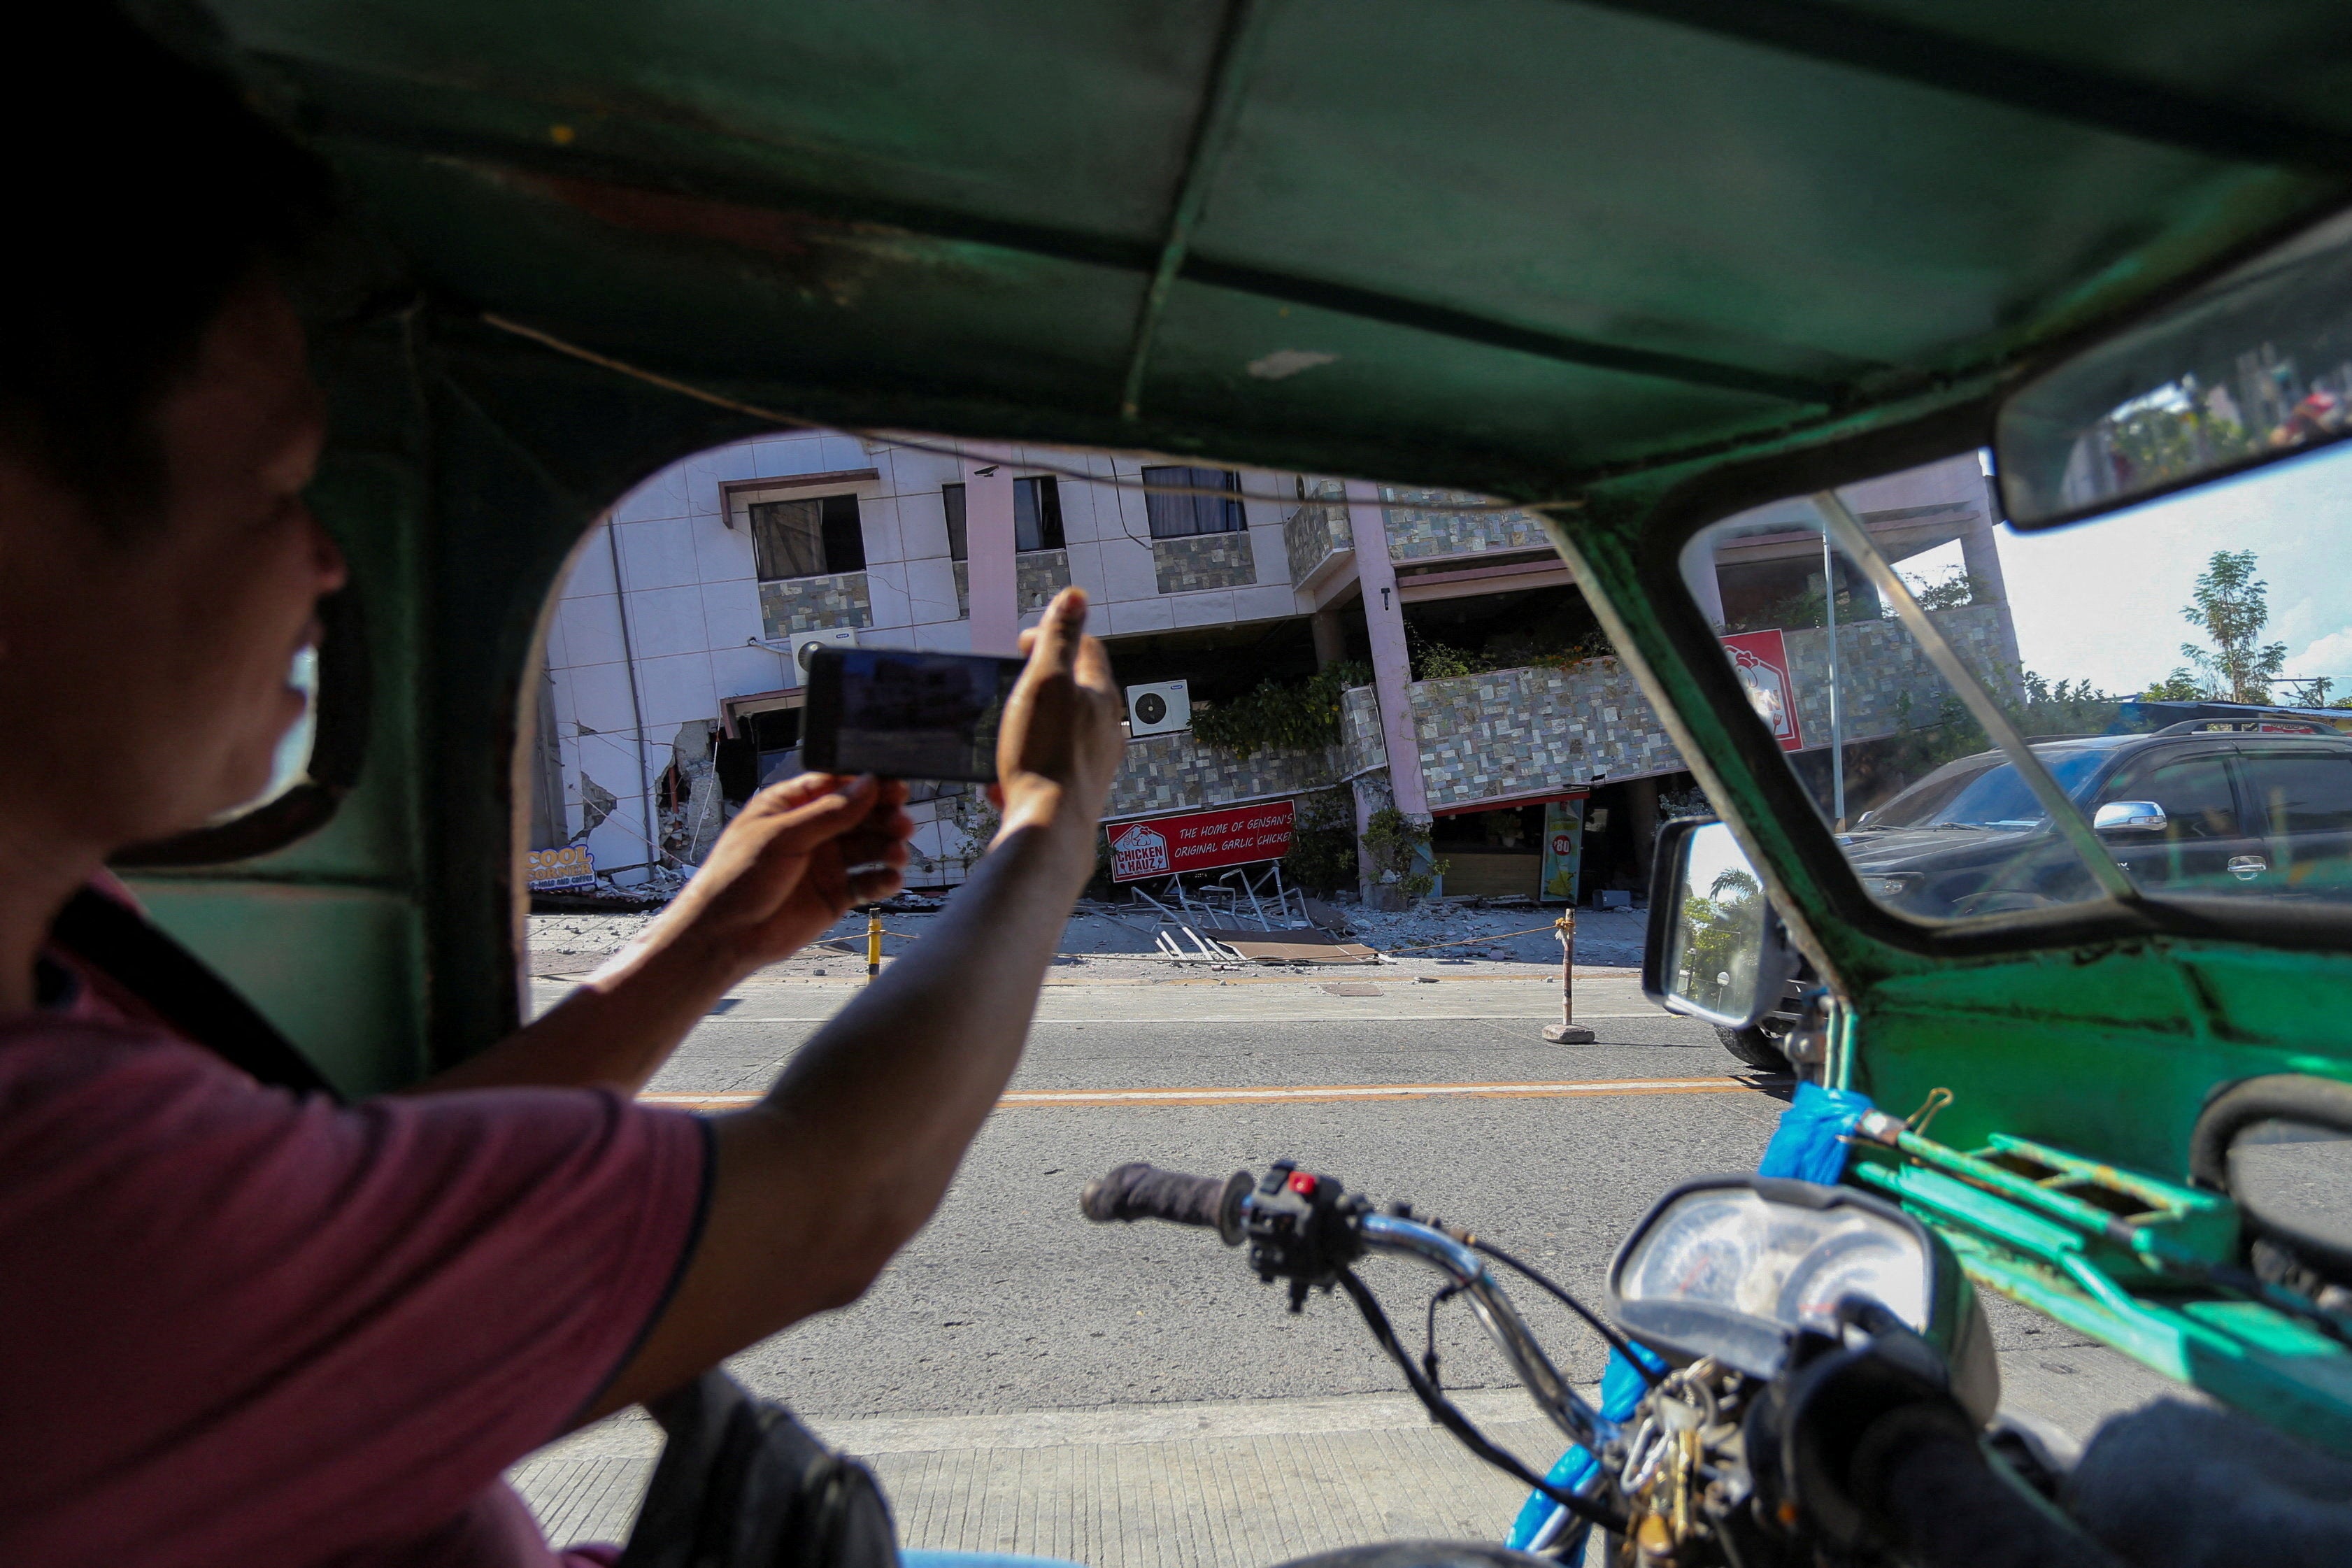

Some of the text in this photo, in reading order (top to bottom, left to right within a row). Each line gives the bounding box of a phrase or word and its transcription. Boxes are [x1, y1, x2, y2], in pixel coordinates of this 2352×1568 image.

[1179, 813, 1293, 839] THE HOME OF GENSAN'S
[1118, 846, 1163, 862] CHICKEN
[1174, 842, 1218, 858] ORIGINAL
[1221, 836, 1254, 851] GARLIC
[525, 846, 592, 869] COOL
[1127, 857, 1156, 872] HAUZ
[526, 862, 593, 881] CORNER
[557, 877, 570, 885] AND
[571, 874, 594, 883] COFFEE
